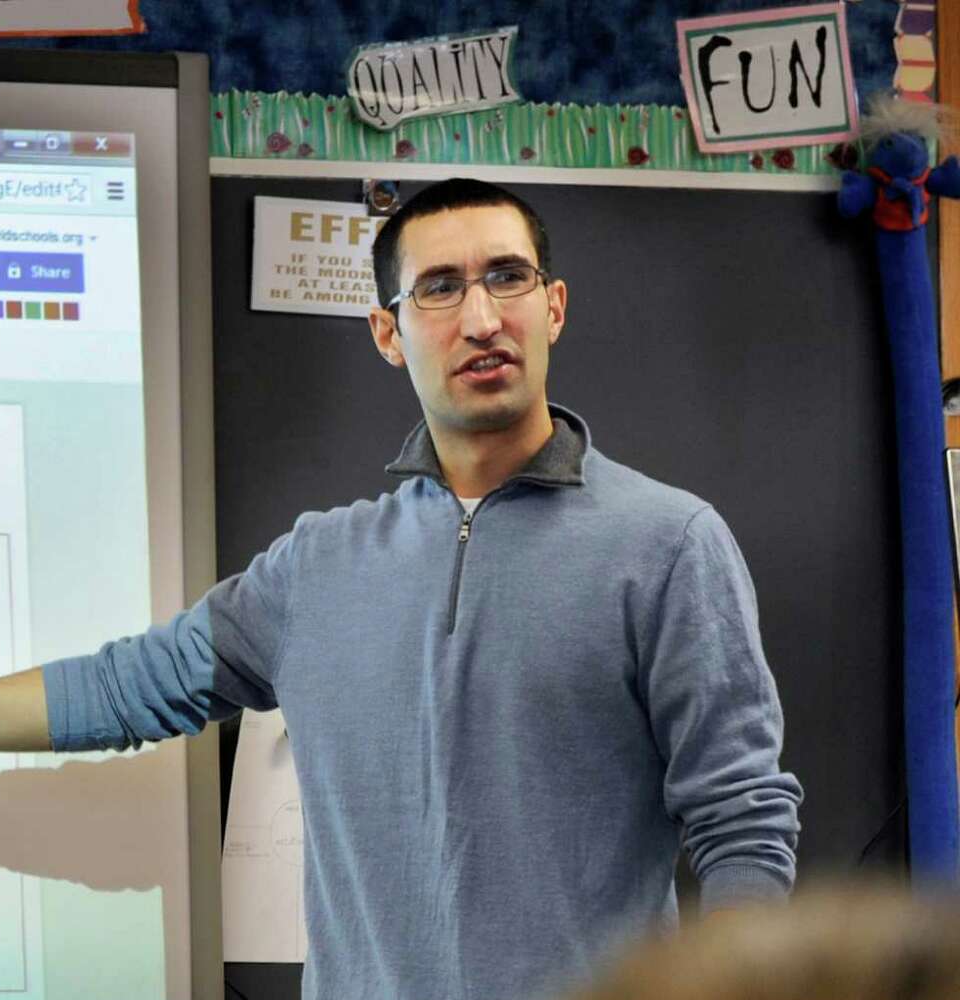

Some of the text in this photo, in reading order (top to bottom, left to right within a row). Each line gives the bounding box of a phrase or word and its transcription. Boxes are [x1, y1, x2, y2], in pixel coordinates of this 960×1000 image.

[698, 25, 827, 135] FUN
[290, 212, 384, 246] EFF
[318, 255, 352, 267] YOU
[30, 265, 71, 280] Share
[275, 264, 373, 280] THE MOON
[298, 279, 376, 293] AT LEAS
[270, 288, 370, 305] BE AMONG
